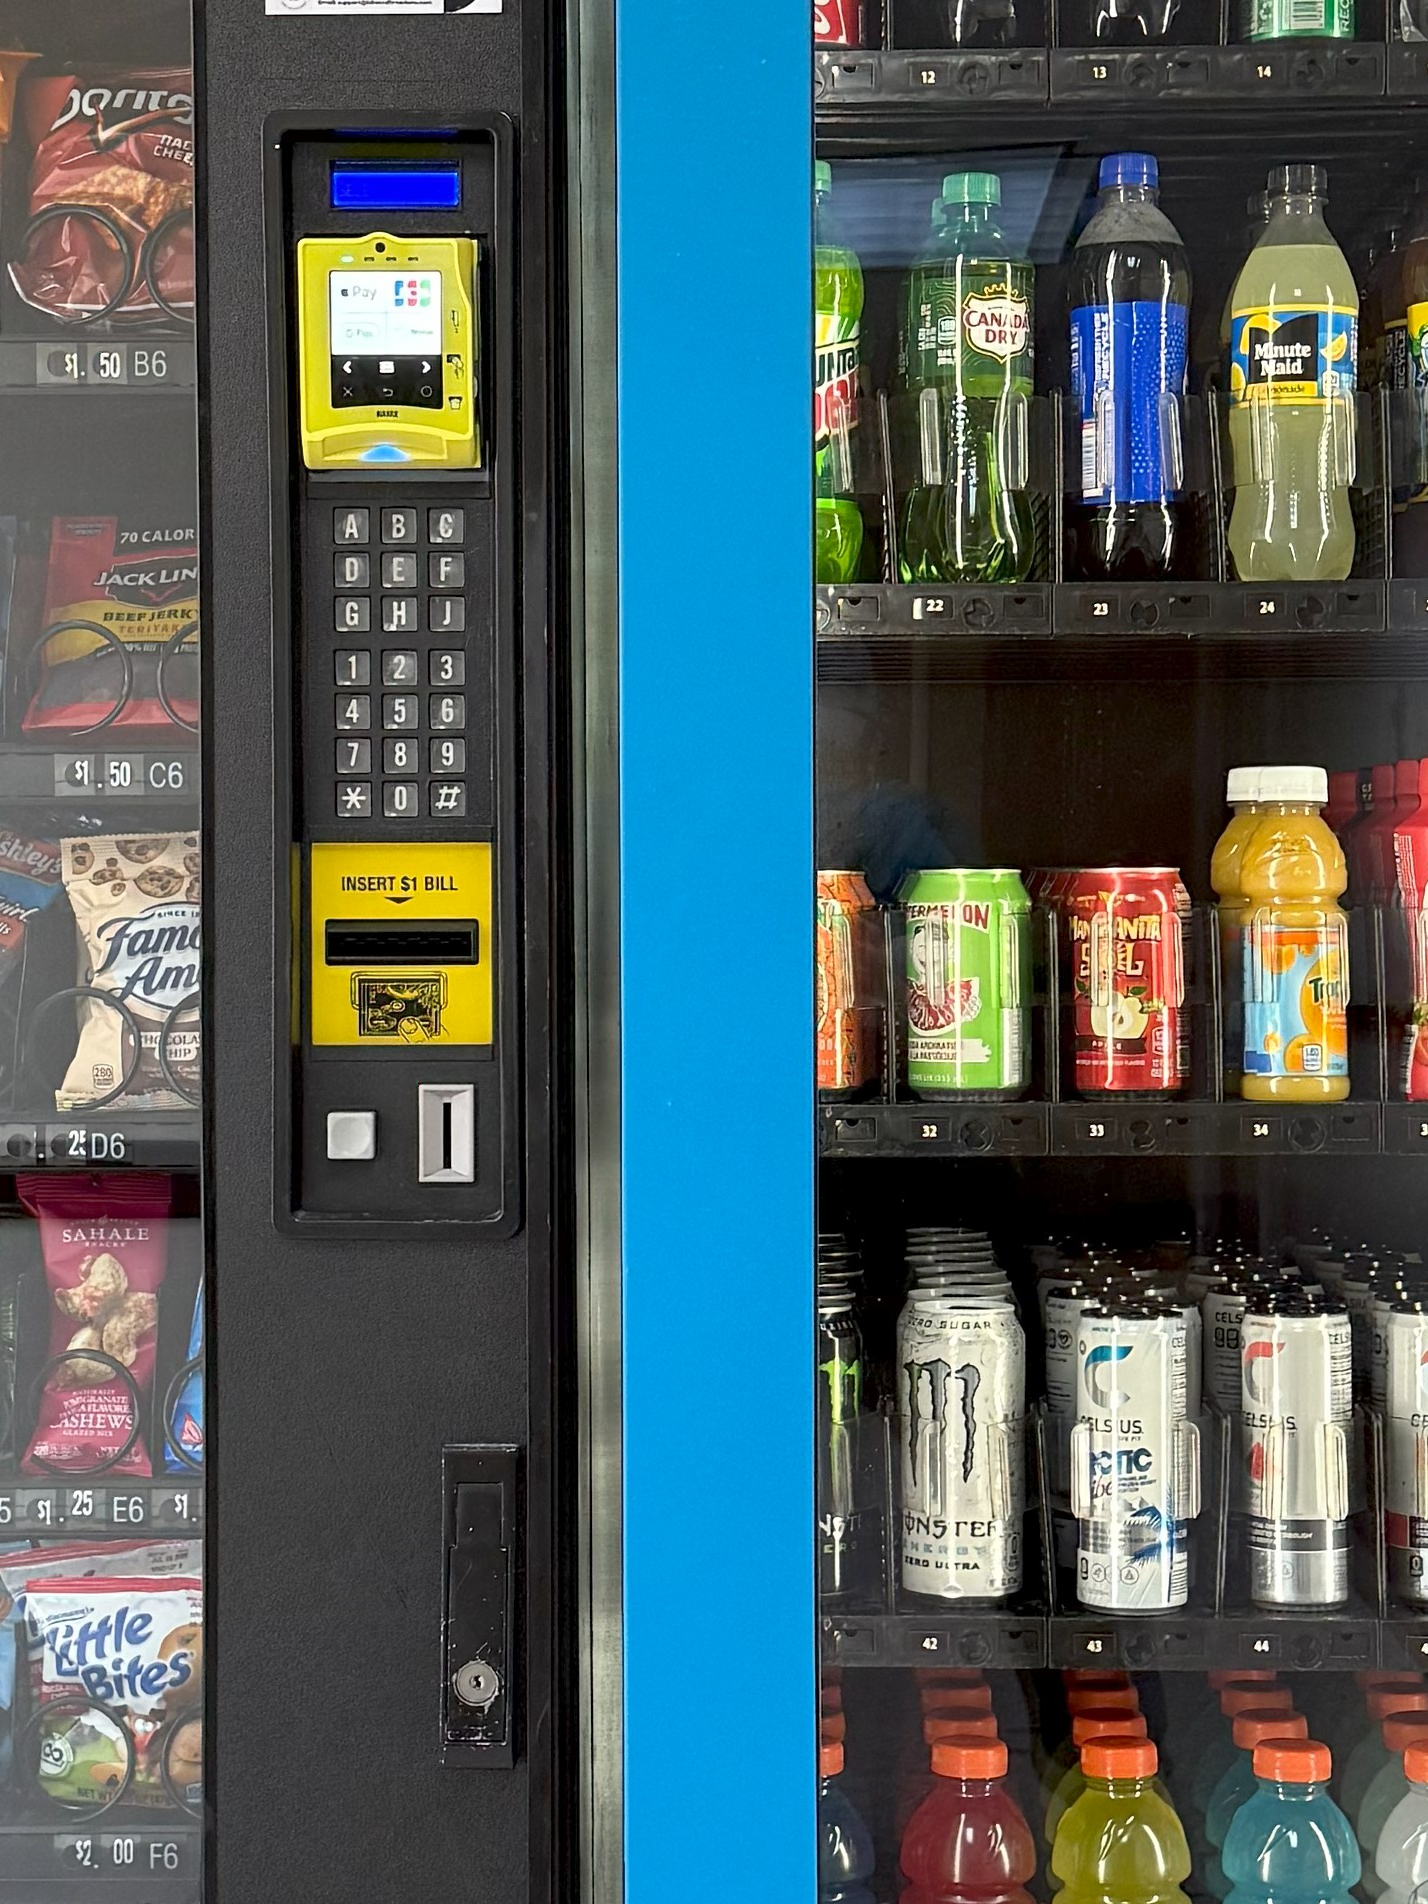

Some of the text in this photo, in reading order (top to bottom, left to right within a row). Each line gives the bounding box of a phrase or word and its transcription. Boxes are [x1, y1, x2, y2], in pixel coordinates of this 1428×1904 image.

[921, 70, 936, 84] 12
[1093, 65, 1107, 79] 13
[1256, 64, 1272, 79] 14
[963, 311, 1029, 330] CANADA
[984, 328, 1018, 345] DRY
[1254, 342, 1311, 360] Minute
[134, 351, 168, 376] B6
[1261, 358, 1304, 376] Maid
[344, 514, 453, 539] A B C
[345, 557, 452, 582] D E F
[345, 601, 452, 627] G H J
[927, 600, 944, 612] 22
[1093, 602, 1108, 615] 23
[1259, 602, 1275, 615] 24
[149, 762, 183, 788] C6
[341, 876, 459, 892] INSERT $1 BILL
[922, 1124, 938, 1138] 32
[1089, 1124, 1105, 1138] 33
[1253, 1124, 1269, 1138] 34
[92, 1133, 126, 1159] D6
[62, 1227, 150, 1243] SAHALE
[113, 1499, 144, 1523] E6
[48, 1605, 153, 1677] Little
[922, 1638, 938, 1651] 42
[1253, 1640, 1270, 1653] 44
[82, 1650, 192, 1699] Bites
[150, 1845, 178, 1869] F6
